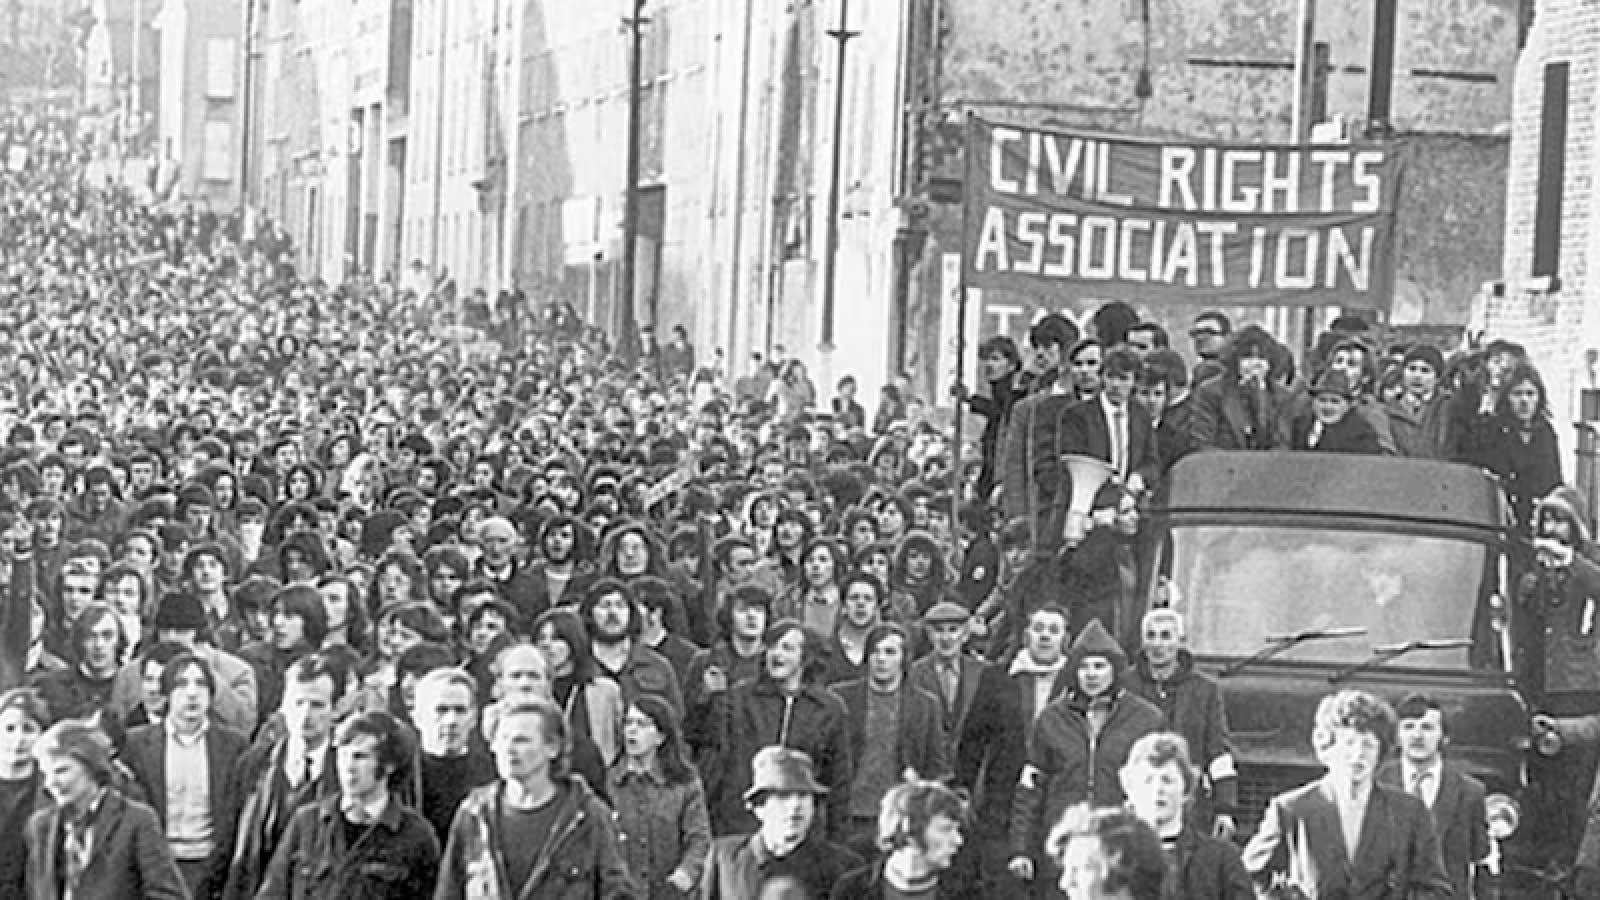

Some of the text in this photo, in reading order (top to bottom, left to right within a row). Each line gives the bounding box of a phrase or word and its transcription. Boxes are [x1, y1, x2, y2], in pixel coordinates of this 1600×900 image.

[991, 127, 1384, 212] CIVIL RIGHTS
[976, 207, 1374, 290] ASSOCIATION
